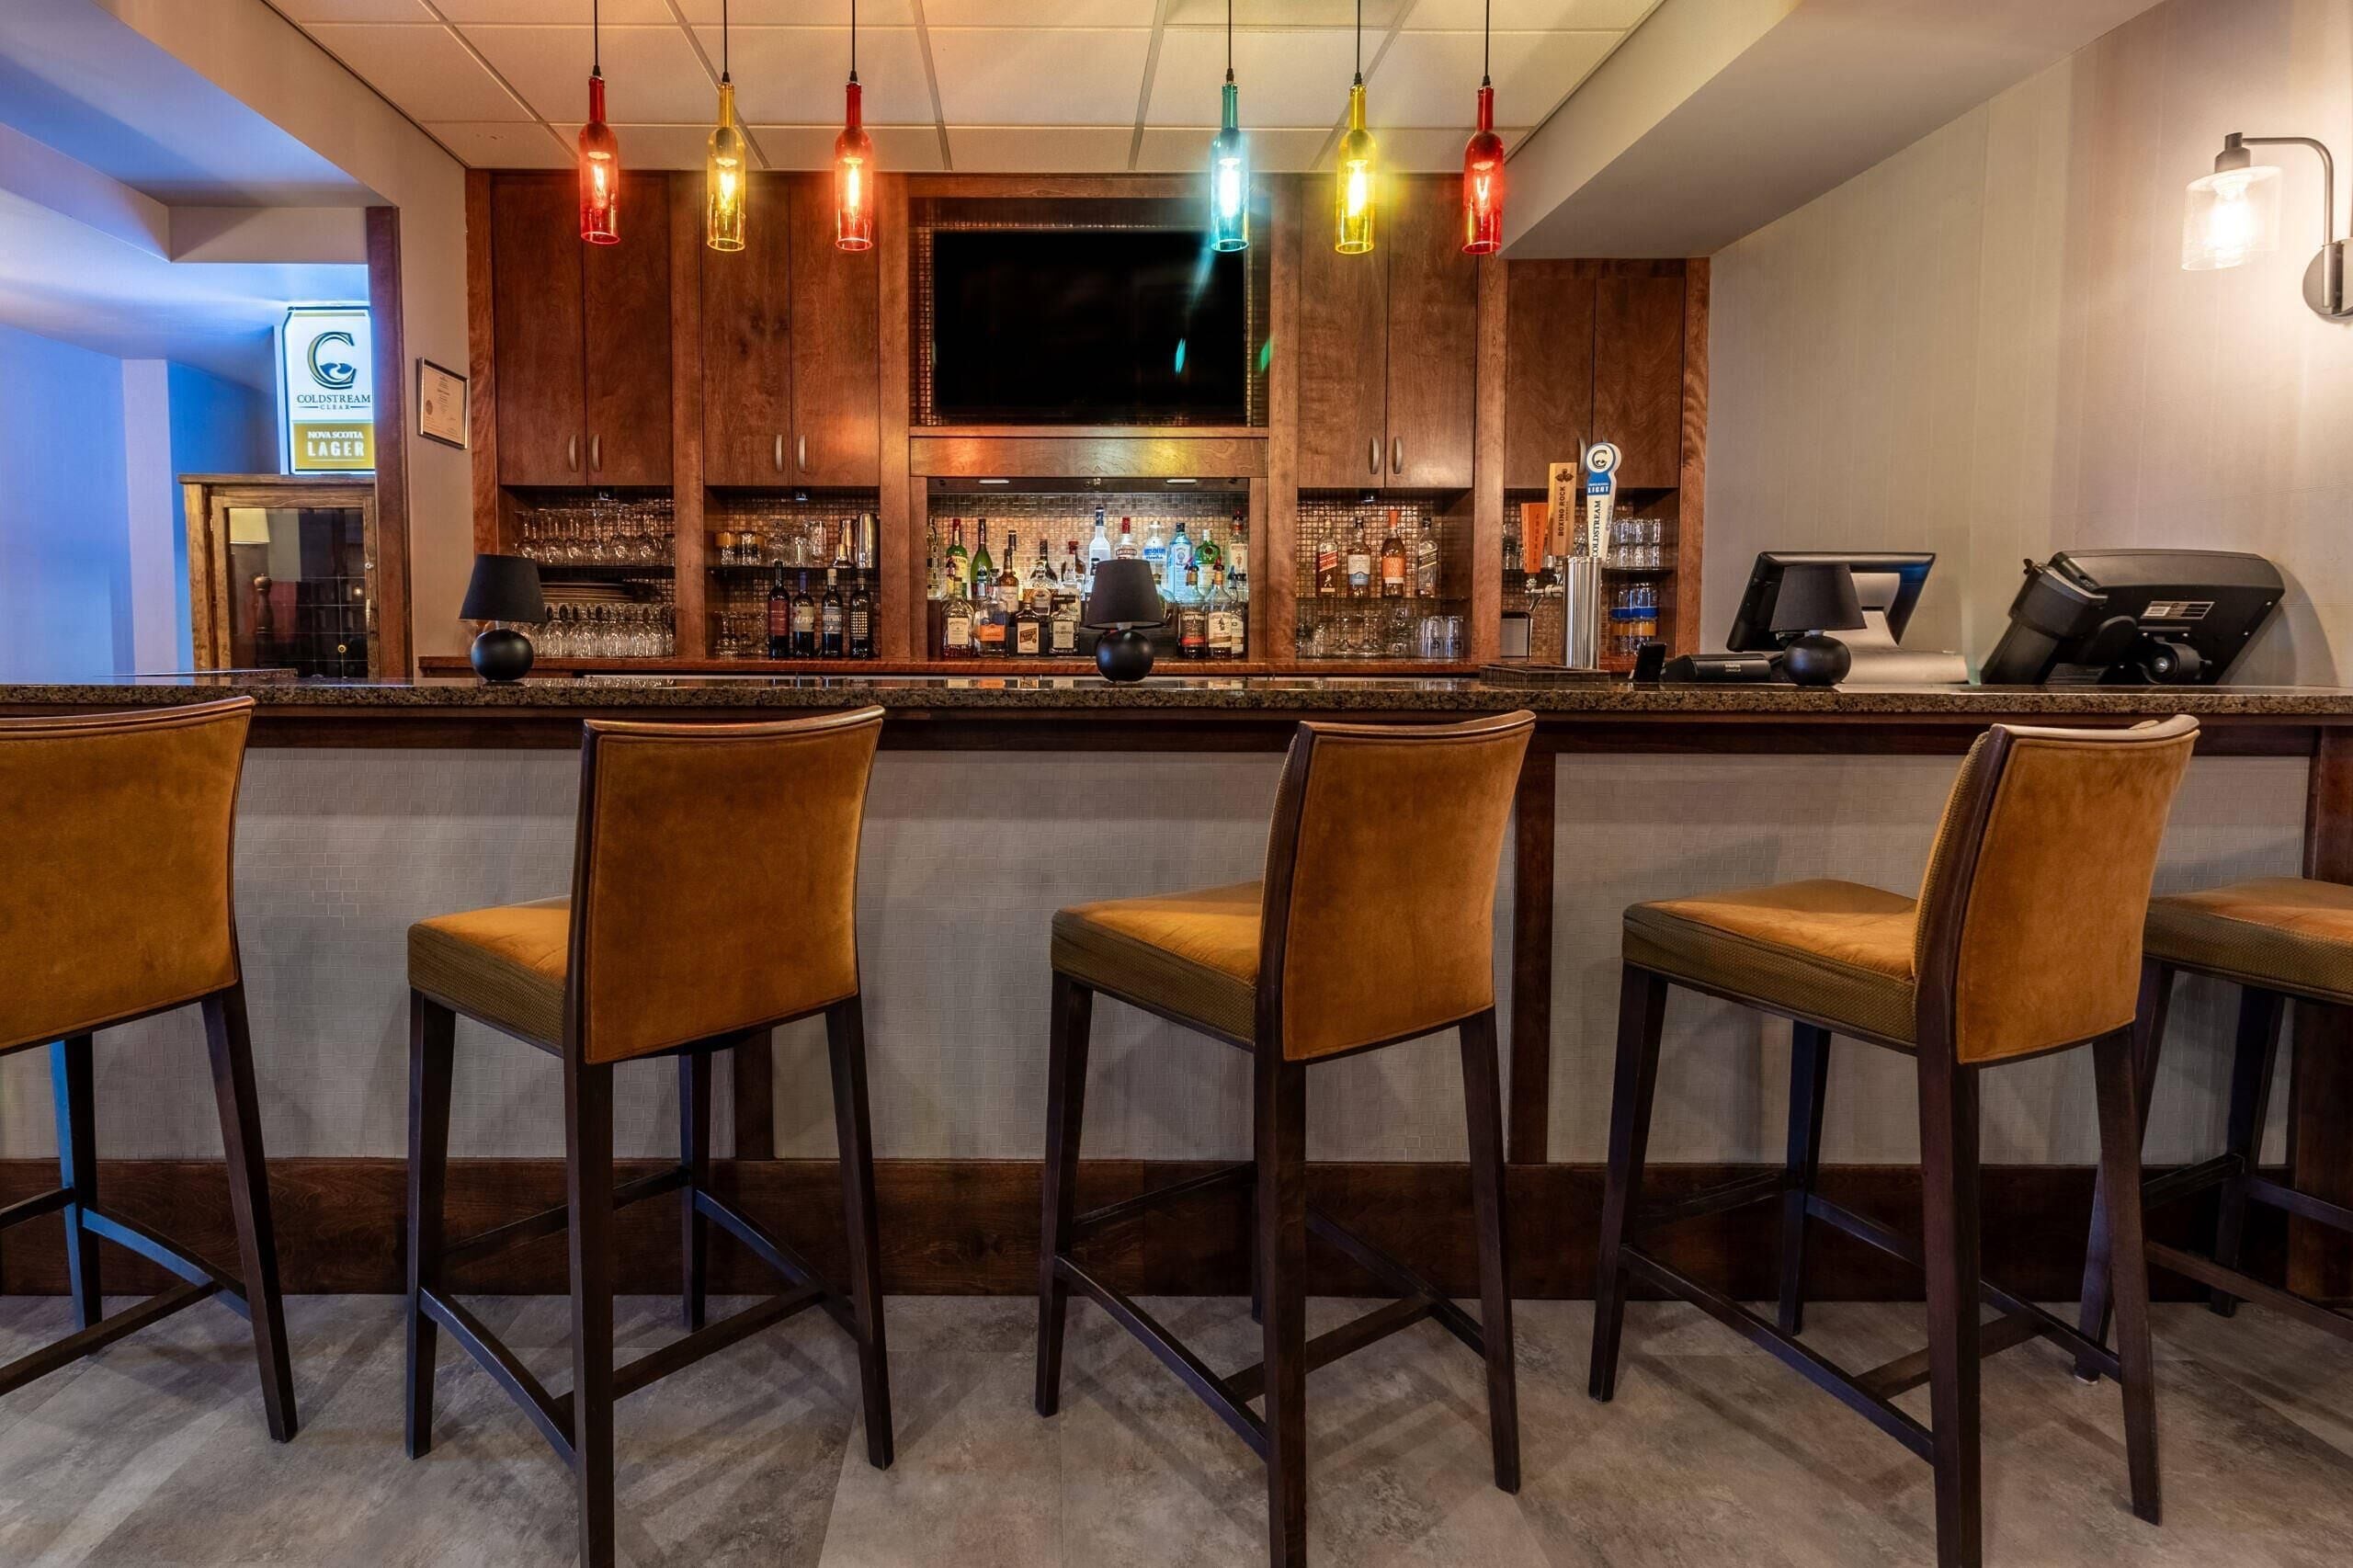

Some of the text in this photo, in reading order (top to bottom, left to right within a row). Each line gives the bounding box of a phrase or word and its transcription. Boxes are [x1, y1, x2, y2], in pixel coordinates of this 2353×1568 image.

[297, 394, 370, 403] COLDSTREAM
[308, 431, 364, 439] NOVA SCOTIA
[307, 441, 364, 457] LAGER
[1592, 500, 1601, 557] COLDSTREAM
